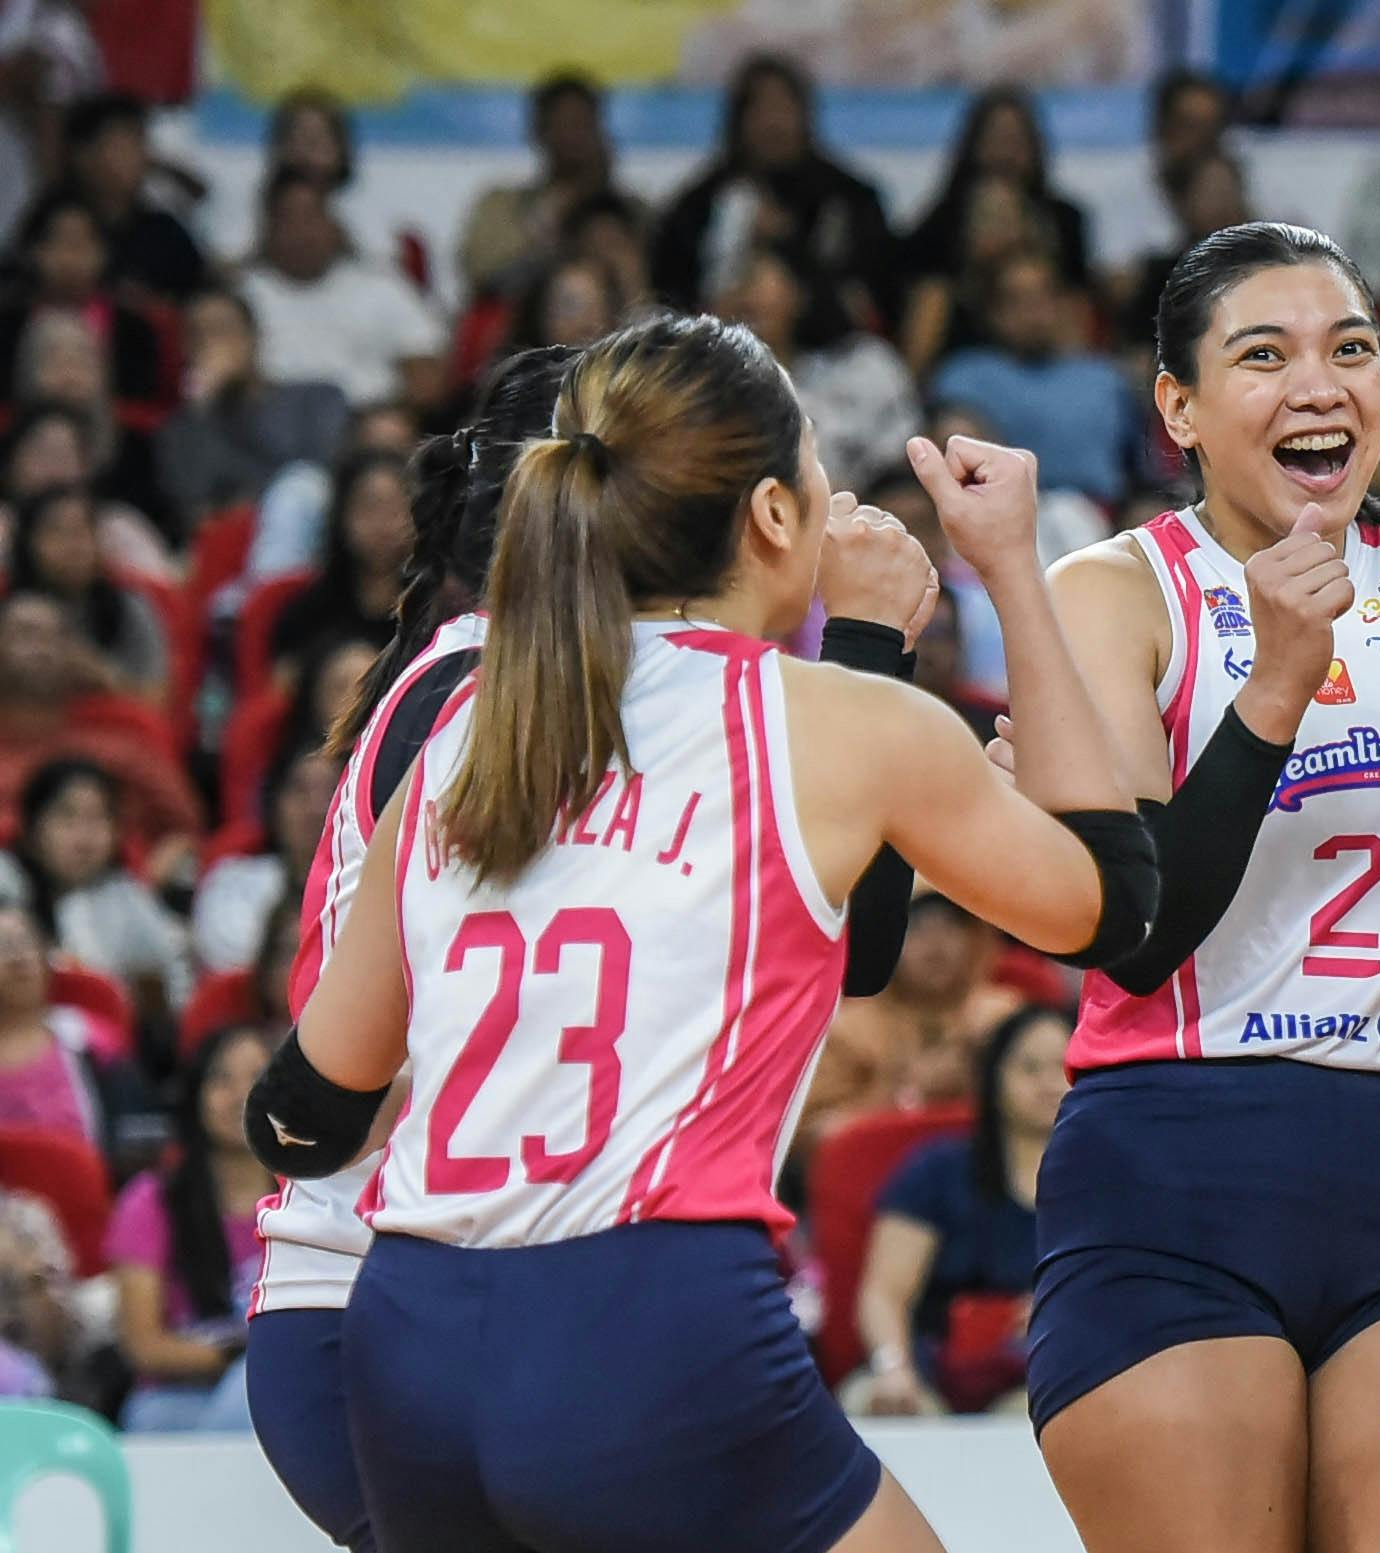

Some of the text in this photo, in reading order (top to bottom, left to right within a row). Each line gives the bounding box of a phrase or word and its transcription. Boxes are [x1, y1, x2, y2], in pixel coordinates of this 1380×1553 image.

[656, 791, 702, 877] J.
[424, 907, 632, 1195] 23
[1239, 1012, 1370, 1043] Allianz
